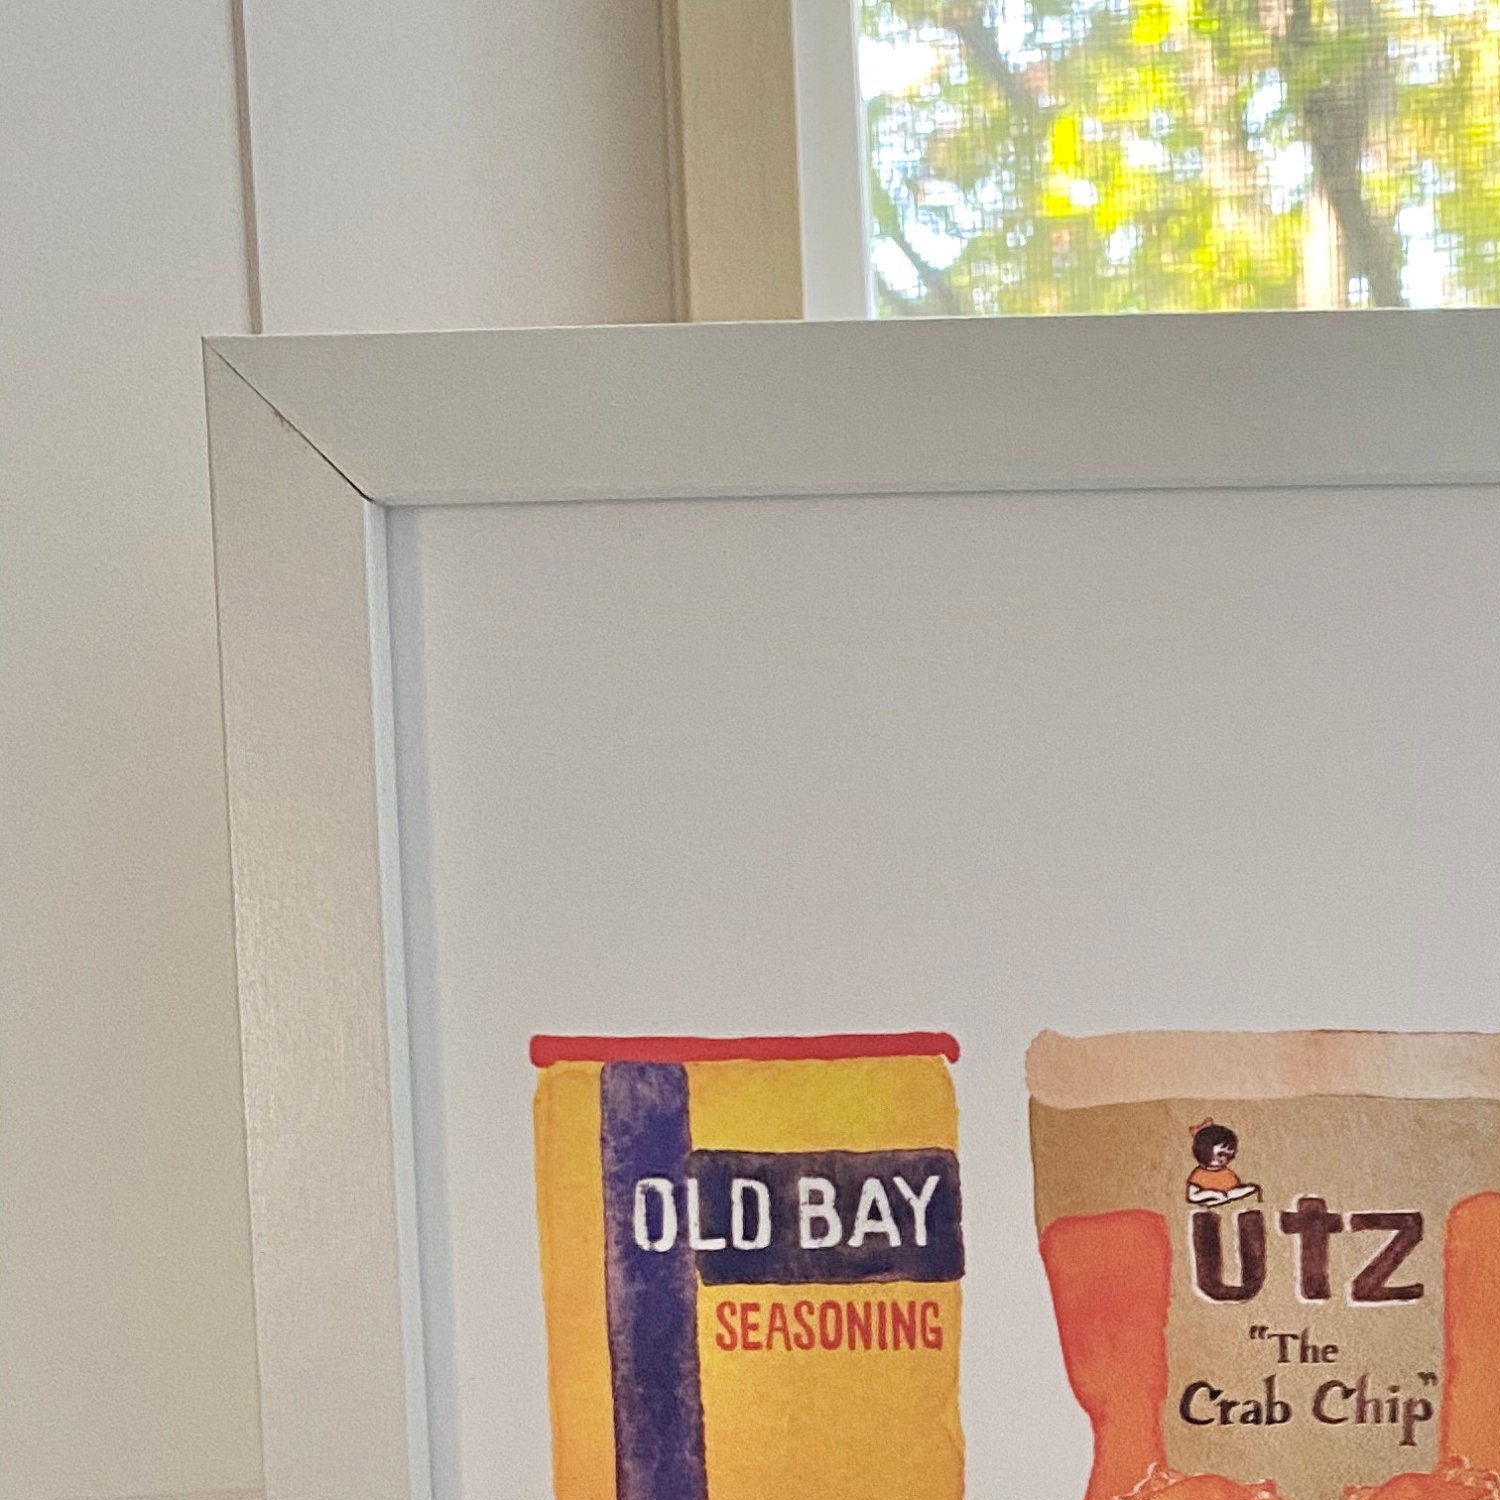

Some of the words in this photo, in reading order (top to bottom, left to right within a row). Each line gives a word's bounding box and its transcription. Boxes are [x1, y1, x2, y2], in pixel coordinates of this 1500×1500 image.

[633, 1177, 771, 1252] OLD
[798, 1176, 940, 1249] BAY
[715, 1300, 943, 1352] SEASONING
[1179, 1374, 1292, 1426] Crab
